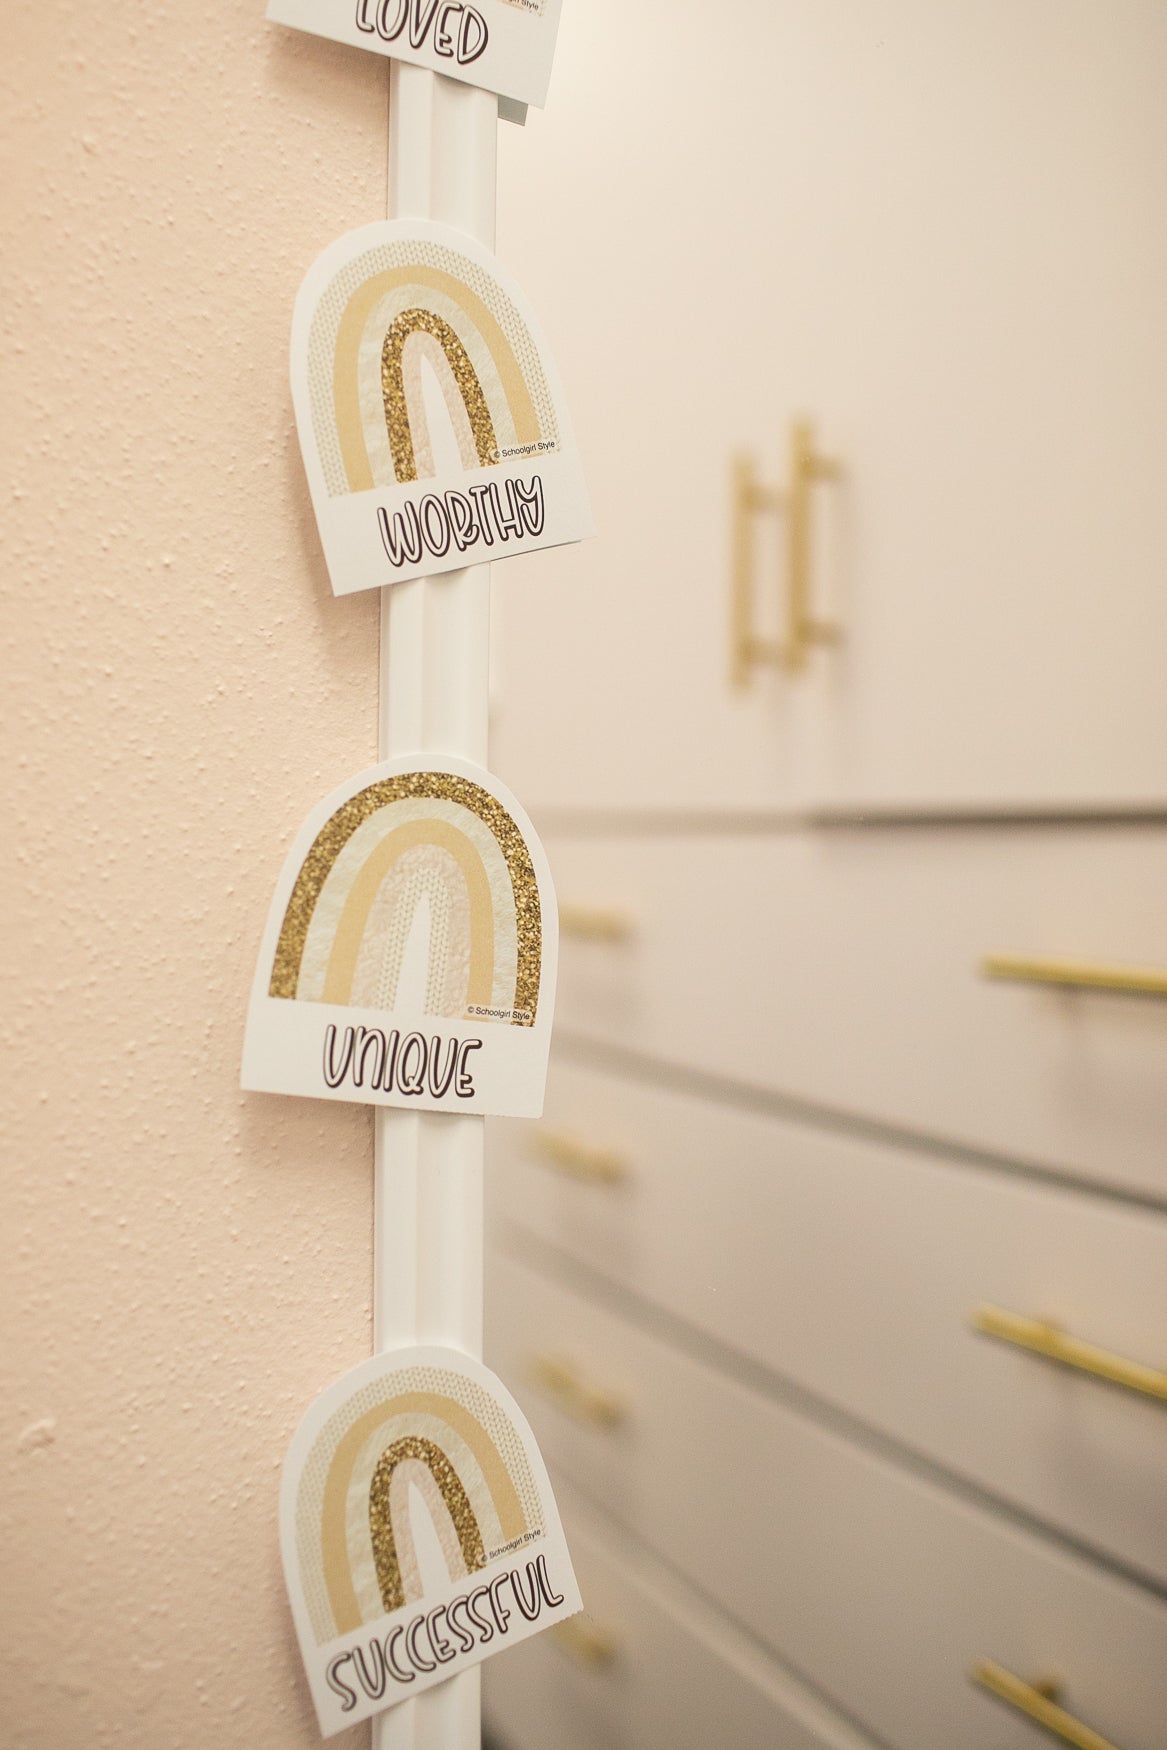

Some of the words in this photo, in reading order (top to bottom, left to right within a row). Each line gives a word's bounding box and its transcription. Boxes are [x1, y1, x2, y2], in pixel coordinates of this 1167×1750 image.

[501, 444, 537, 457] Schoolgirl
[537, 441, 555, 451] Style
[377, 475, 545, 567] WORTHY
[475, 1006, 511, 1019] Schoolgirl
[512, 1010, 530, 1020] Style
[489, 1537, 523, 1559] Schoolgirl
[523, 1529, 541, 1542] Style
[325, 1554, 565, 1712] SUCCESSFUL
